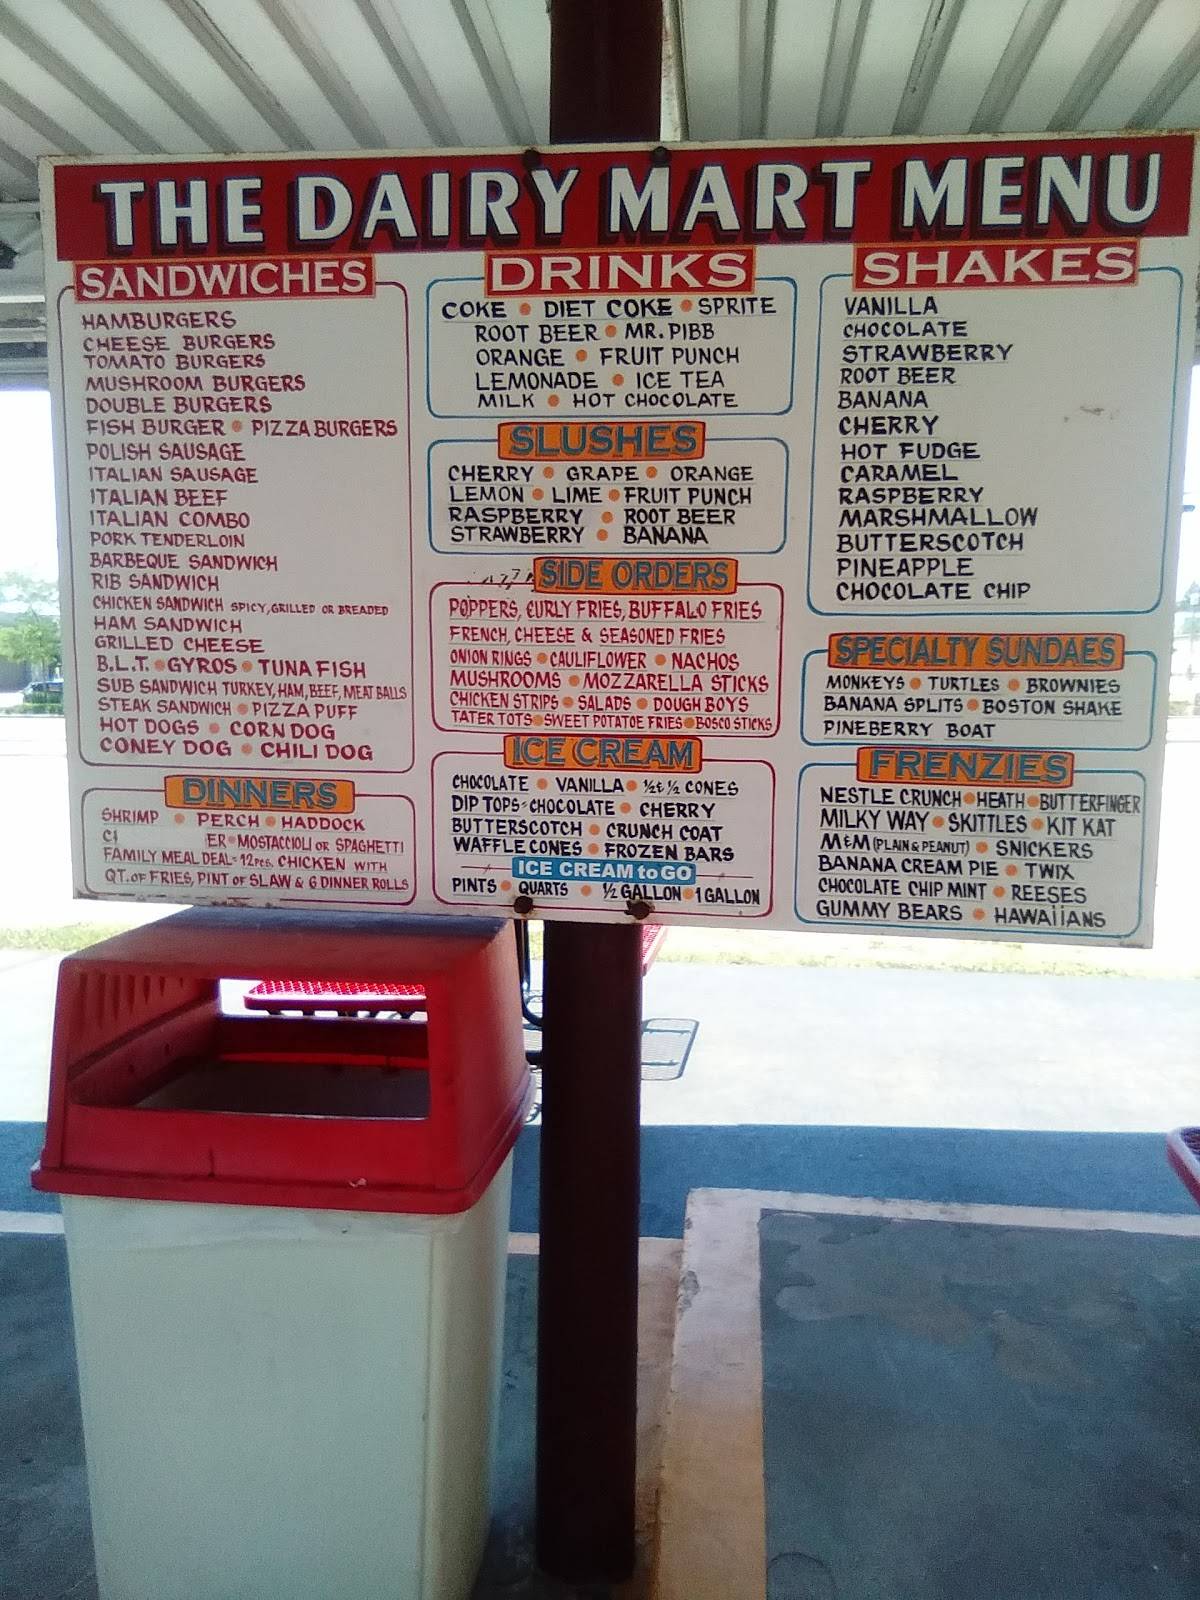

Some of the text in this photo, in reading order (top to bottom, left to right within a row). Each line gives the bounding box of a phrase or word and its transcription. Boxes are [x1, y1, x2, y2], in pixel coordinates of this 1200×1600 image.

[101, 153, 1162, 245] THE DAIRY MART MENU
[491, 253, 747, 292] DRINKS
[863, 247, 1135, 285] SHAKES
[81, 260, 368, 299] SANDWICHES
[442, 298, 776, 319] COKE DIET COKE SPRITE
[844, 297, 938, 315] VANILLA
[82, 311, 237, 331] HAMBURGERS
[843, 321, 967, 338] CHOCOLATE
[476, 323, 715, 343] ROOT BEER MR. PIBB
[83, 334, 275, 352] CHEESE BURGERS
[476, 347, 739, 366] ORANGE FRUIT PUNCH
[842, 344, 1013, 363] STRAWBERRY
[86, 374, 306, 392] MUSHROOM BURGERS
[476, 371, 725, 390] LEMONADE ICE TEA
[841, 367, 955, 384] ROOT BEER
[86, 396, 272, 414] DOUBLE BURGERS
[478, 393, 738, 408] MILK HOT CHOCOLATE
[837, 391, 928, 408] BANANA
[86, 419, 398, 438] FISH BURGER PIZZA BURGERS
[839, 416, 939, 435] CHERRY
[511, 425, 697, 457] SLUSHES
[86, 443, 246, 461] POLISH SAUSAGE
[841, 443, 980, 460] HOT FUDGE
[89, 466, 258, 483] ITALIAN SAUSAGE
[449, 465, 754, 482] CHERRY GRAPE ORANGE
[841, 465, 958, 482] CARAMEL
[91, 489, 228, 506] ITALIAN BEEF
[450, 487, 751, 505] LEMON LIME FRUIT PUNCH
[840, 487, 983, 504] RASPBERRY
[90, 511, 249, 528] ITALIAN COMBO
[449, 507, 735, 525] RASPBERRY ROOT BEER
[839, 507, 1038, 527] MARSHMALLOW
[91, 532, 245, 548] PORK TENDERLOIN
[451, 526, 709, 544] STRAWBERRY BANANA
[837, 532, 1023, 552] BUTTERSCOTCH
[90, 553, 278, 571] BARBEQUE SANDWICH
[837, 558, 974, 576] PINEAPPLE
[91, 573, 218, 591] RIB SANDWICH
[540, 560, 603, 590] SIDE
[612, 560, 729, 591] ORDERS
[836, 582, 1030, 600] CHOCOLATE CHIP
[94, 617, 242, 634] HAM SANDWICH
[95, 636, 265, 653] GRILLED CHEESE
[836, 635, 1115, 666] SPECIALTY SUNDAES
[97, 656, 366, 677] B.L.T. GYROS TUNA FISH
[450, 650, 739, 670] ONION RINGS CAULIFLOWER NACHOS
[450, 670, 769, 693] MUSHROOMS MOZZARELLA STICKS
[826, 676, 1120, 693] MONKEYS TURTLES BROWNIES
[450, 691, 749, 712] CHICKEN STRIPS SALADS DOUGH BOYS
[824, 697, 1122, 716] BANANA SPLITS BOSTON SHAKE
[100, 717, 335, 739] HOT DOGS CORN DOG
[824, 721, 995, 738] PINEBERRY BOAT
[100, 738, 373, 760] CONEY DOG CHILI DOG
[513, 738, 693, 769] ICE CREAM
[871, 750, 1068, 782] FRENZIES
[183, 778, 337, 809] DINNERS
[102, 810, 365, 830] SHRIMP PERCH HADDOCK
[820, 809, 1116, 836] MILKY WAY SKITTLES KIT KAT
[452, 819, 723, 841] BUTTERSCOTCH CRUNCH COAT
[454, 837, 734, 861] WAFFLE CONES FROZEN BARS
[518, 861, 692, 880] ICE CREAM to GO
[818, 855, 1074, 880] BANANA CREAM PIE TWIX
[819, 878, 1086, 903] CHOCOLATE CHIP MINT REESES
